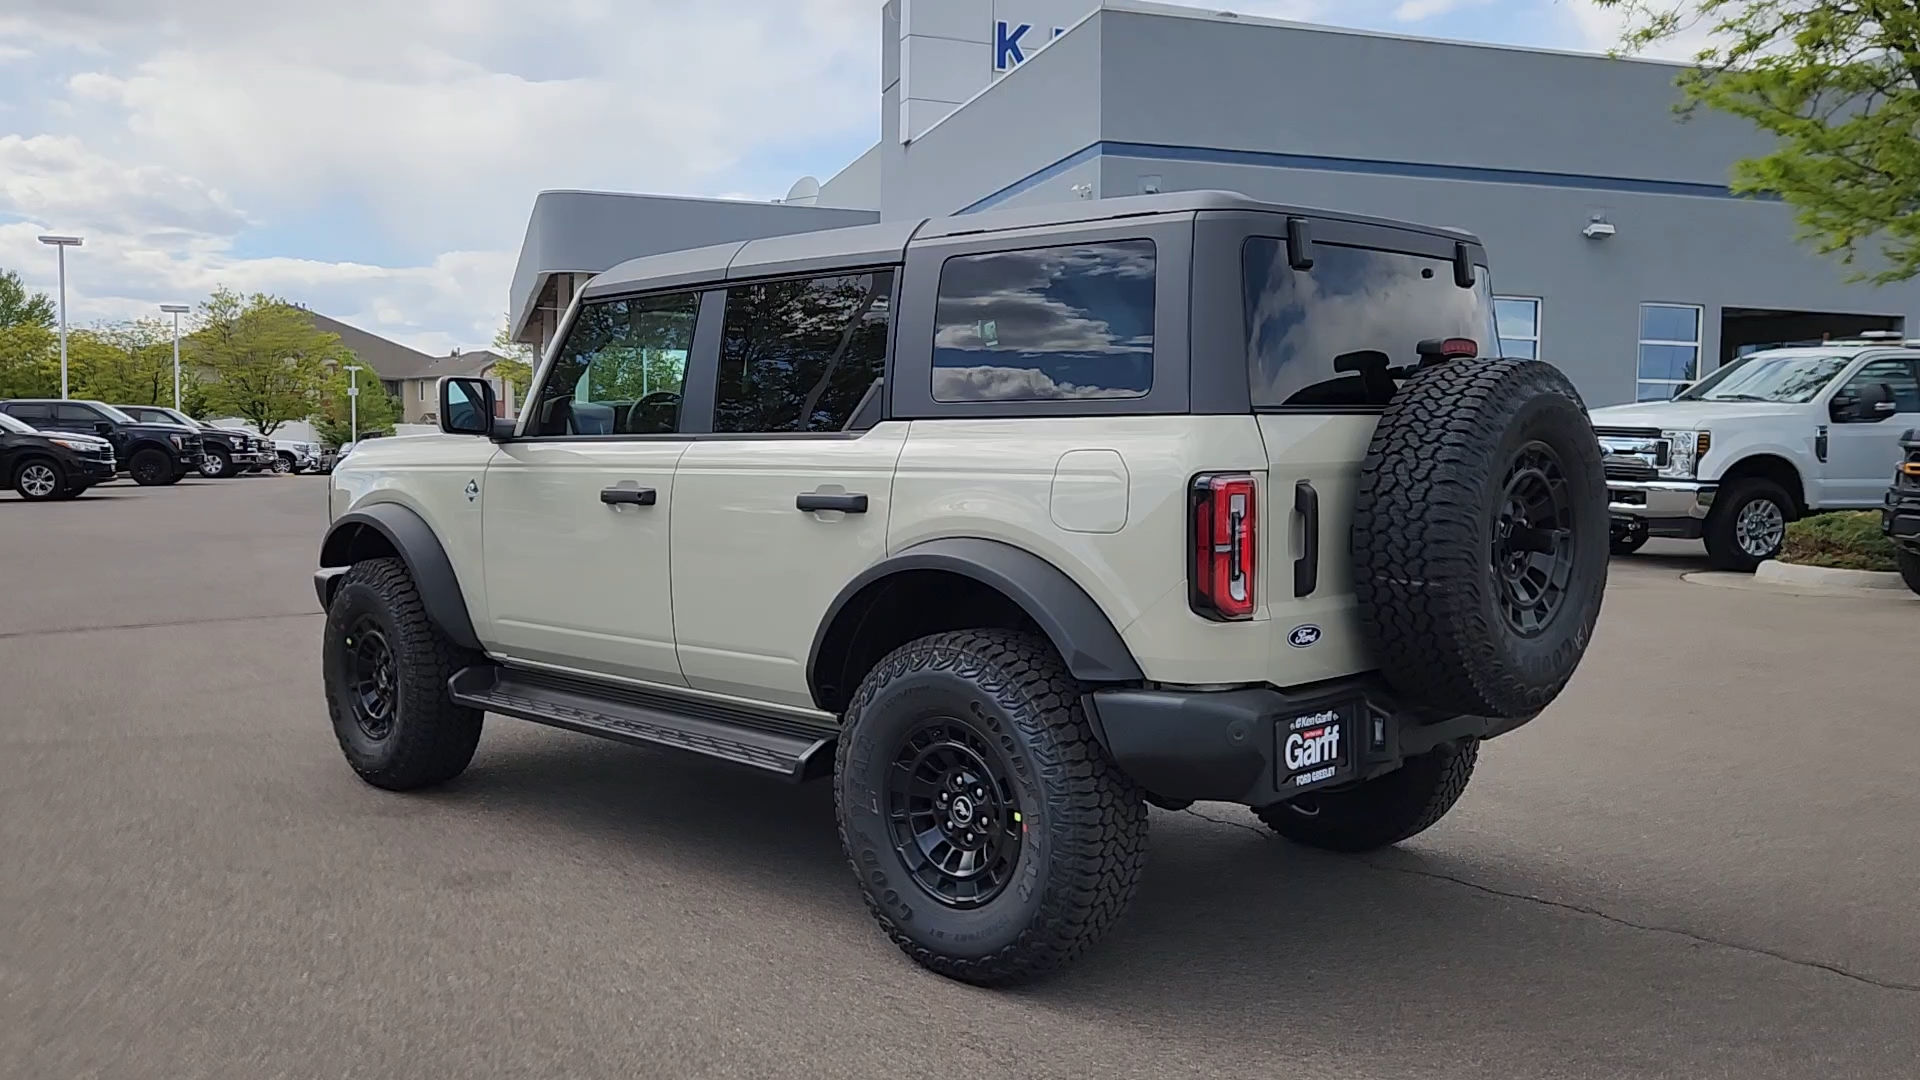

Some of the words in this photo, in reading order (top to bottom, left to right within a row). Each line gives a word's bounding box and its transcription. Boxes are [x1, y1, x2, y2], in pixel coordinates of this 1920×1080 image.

[1315, 710, 1334, 725] Garff
[1285, 725, 1340, 771] Garff
[1296, 772, 1312, 788] FORD
